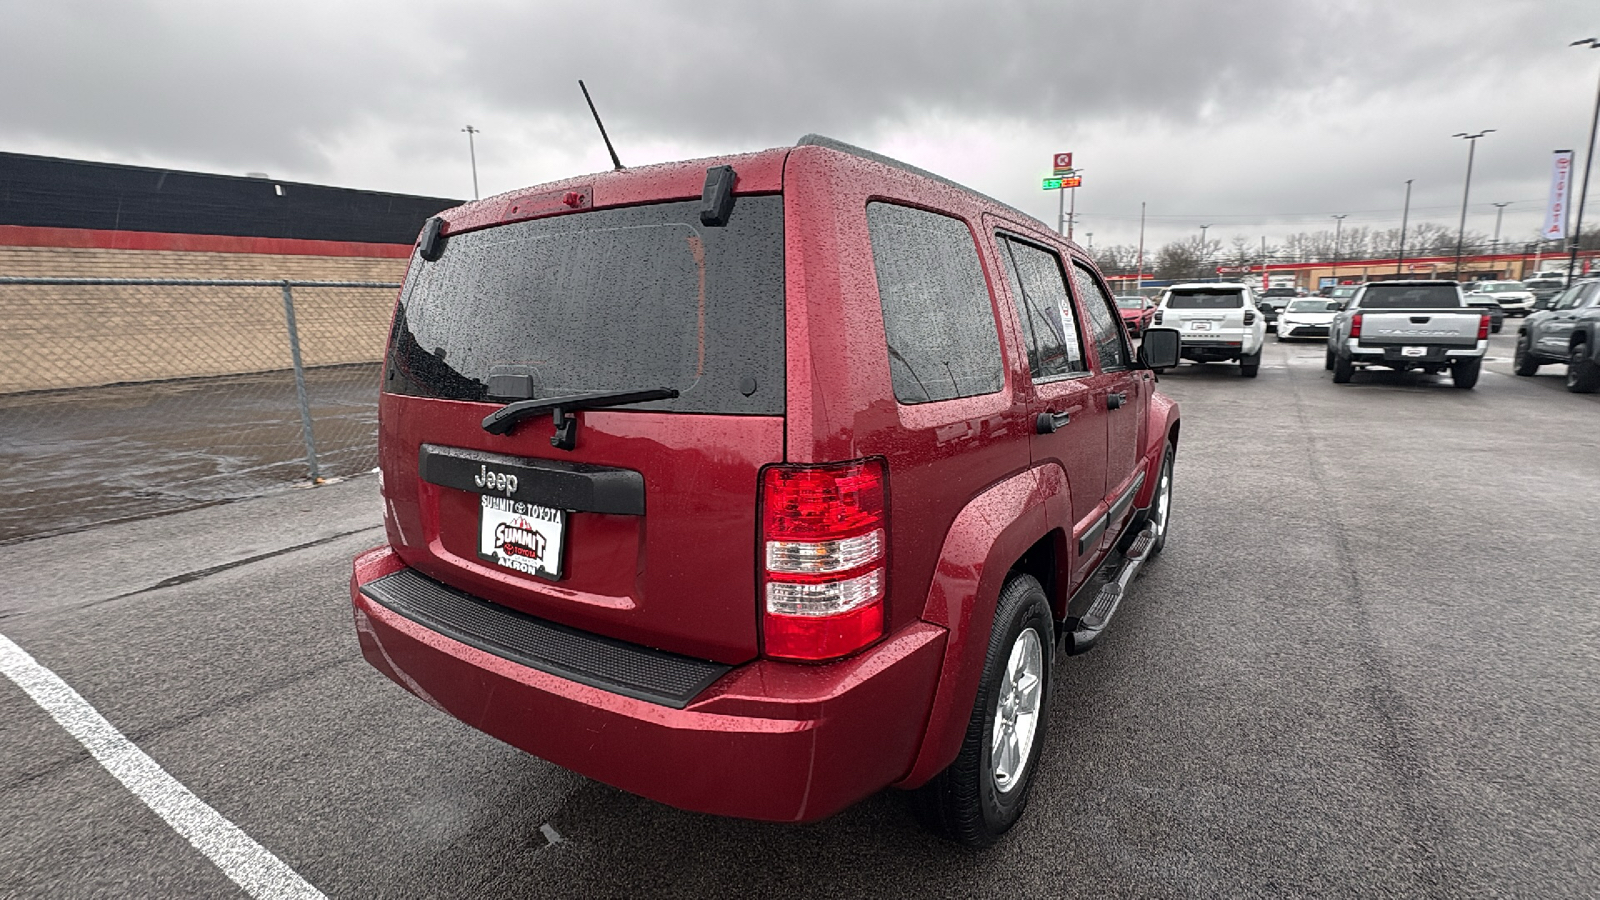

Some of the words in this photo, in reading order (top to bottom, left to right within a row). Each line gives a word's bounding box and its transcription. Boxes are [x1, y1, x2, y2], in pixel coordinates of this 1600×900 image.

[1547, 171, 1567, 233] TOYOTA
[475, 464, 518, 497] Jeep
[481, 494, 515, 513] SUMMIT
[526, 503, 561, 524] TOYOTA
[495, 523, 546, 560] SUMMIT
[514, 546, 536, 558] TOYOTA
[497, 557, 536, 575] AKRON
